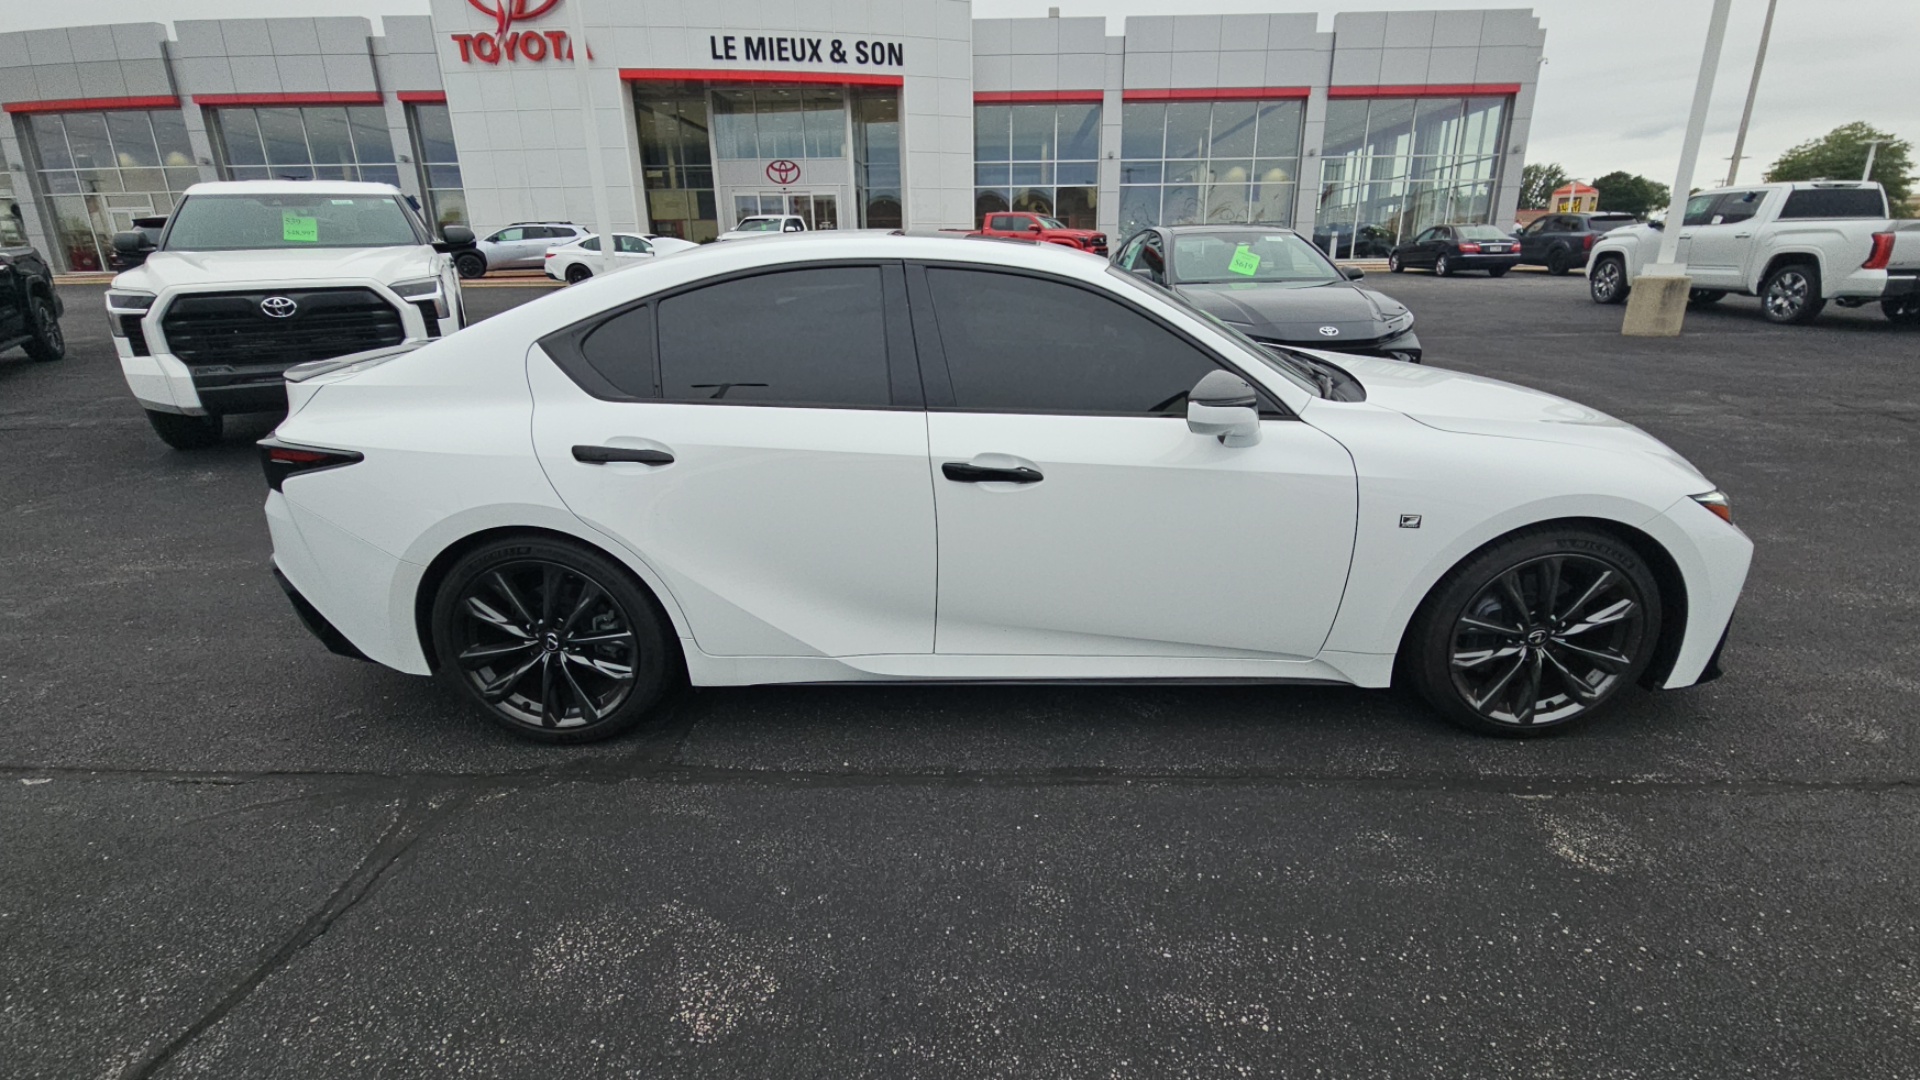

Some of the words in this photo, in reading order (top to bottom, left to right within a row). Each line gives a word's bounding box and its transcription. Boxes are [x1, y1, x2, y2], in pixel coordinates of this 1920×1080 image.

[710, 36, 737, 60] LE
[744, 36, 823, 63] MIEUX
[829, 39, 848, 64] &
[855, 40, 904, 66] SON
